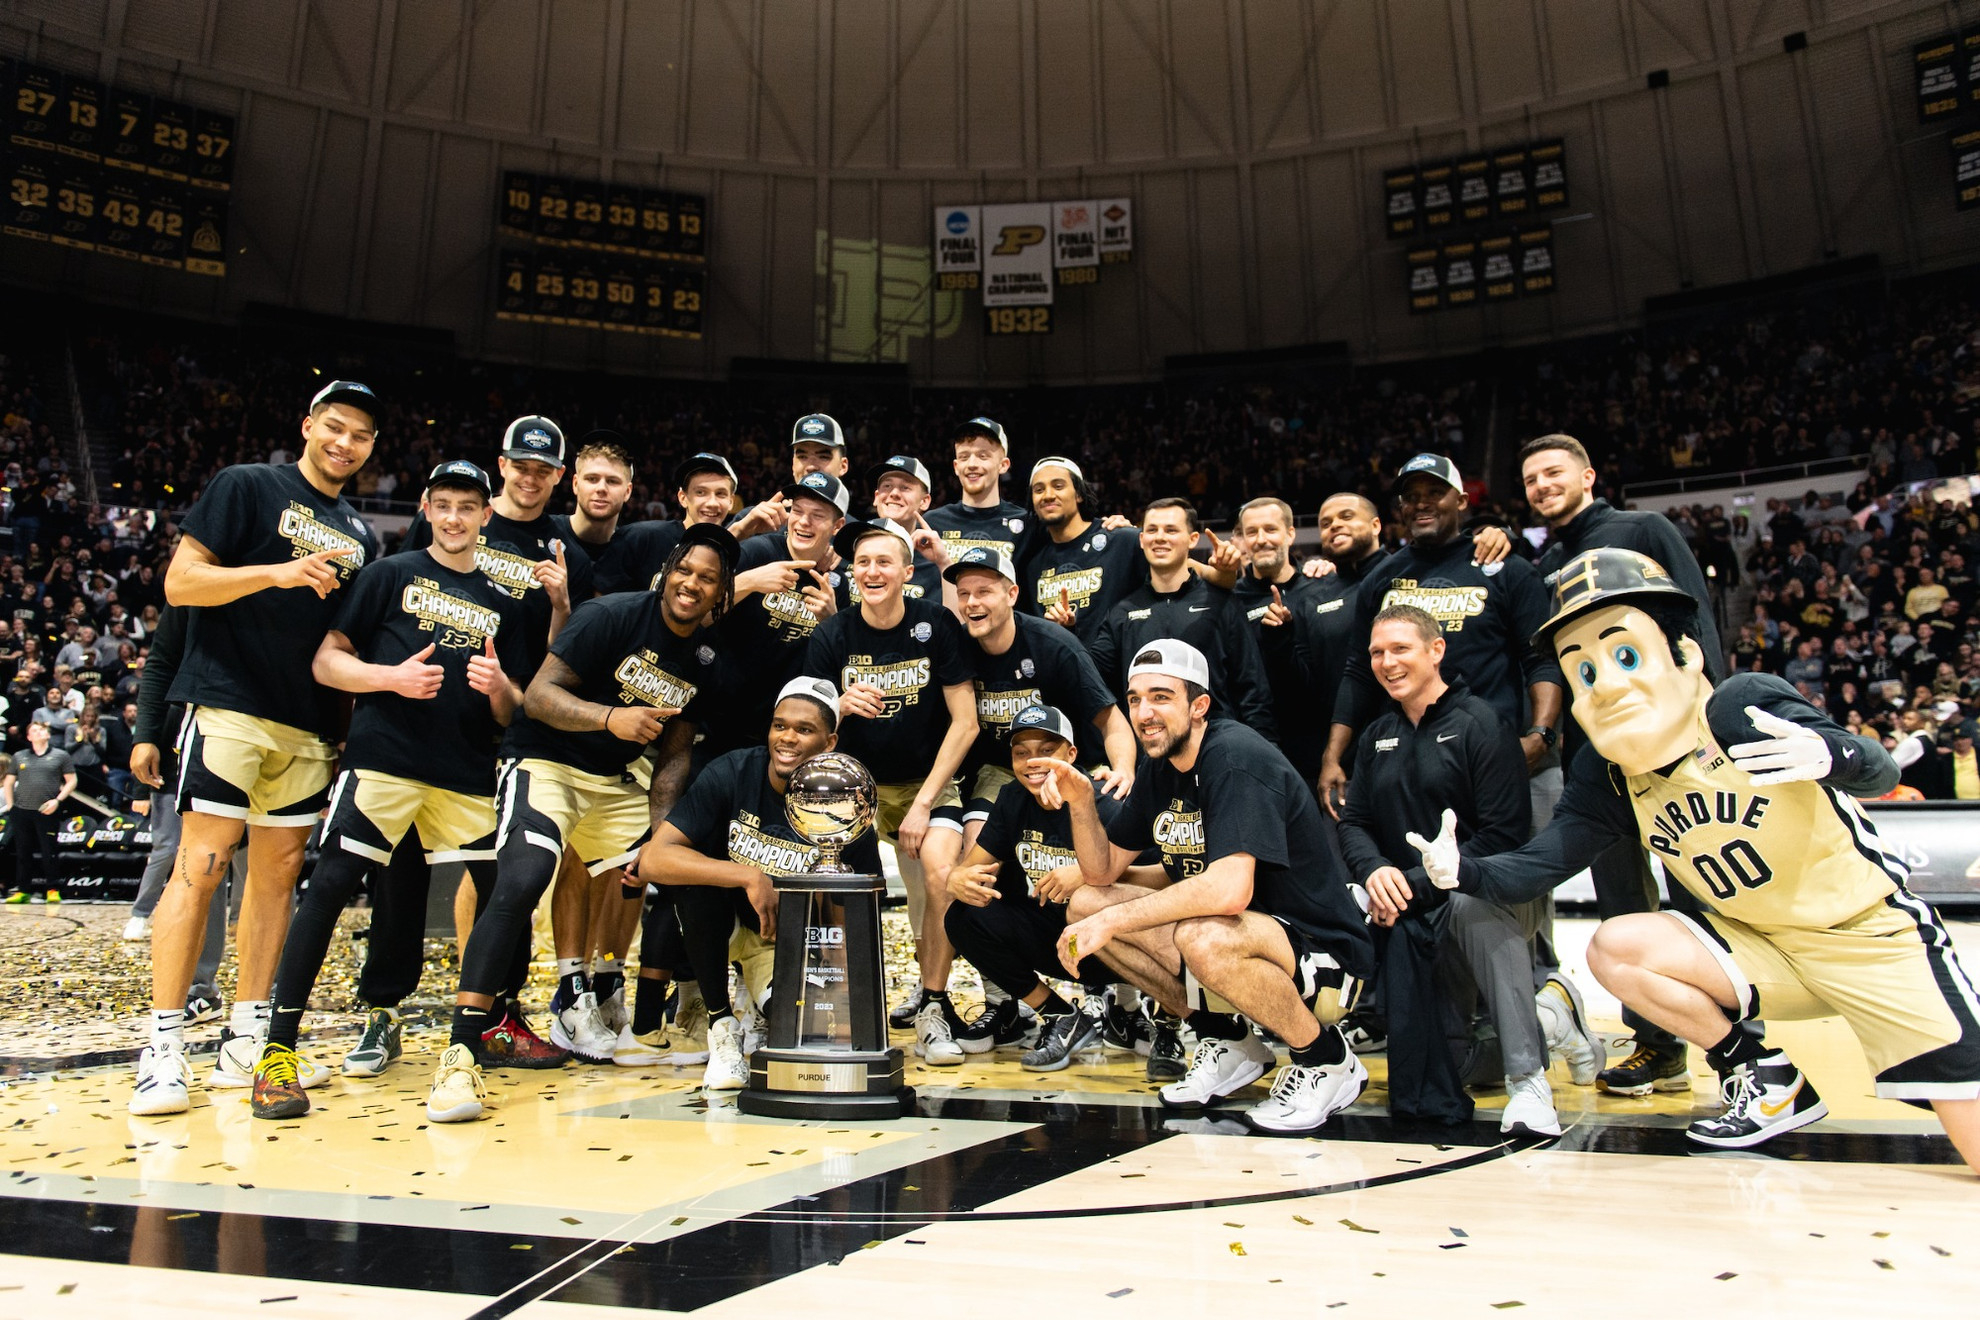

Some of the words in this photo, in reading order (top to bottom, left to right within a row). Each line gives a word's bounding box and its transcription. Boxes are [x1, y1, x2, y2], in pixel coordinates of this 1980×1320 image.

[16, 87, 57, 116] 27
[69, 100, 98, 128] 13
[119, 112, 138, 137] 7
[153, 122, 188, 151] 23
[195, 132, 230, 159] 37
[10, 178, 49, 208] 32
[57, 188, 94, 218] 35
[507, 189, 531, 211] 10
[102, 199, 140, 228] 43
[540, 196, 568, 219] 22
[573, 200, 602, 223] 23
[608, 204, 636, 227] 33
[146, 209, 183, 237] 42
[642, 209, 669, 232] 55
[678, 213, 701, 236] 13
[940, 238, 977, 251] FINAL
[1057, 231, 1095, 246] FINAL
[942, 251, 975, 264] FOUR
[1060, 246, 1094, 259] FOUR
[507, 270, 523, 292] 4
[536, 273, 565, 296] 25
[939, 272, 979, 289] 1969
[992, 273, 1043, 283] NATIONAL
[1058, 267, 1098, 285] 1980
[570, 278, 599, 300] 33
[607, 281, 635, 304] 50
[648, 286, 662, 308] 3
[988, 284, 1049, 295] CHAMPIONS
[672, 290, 700, 312] 23
[988, 307, 1049, 334] 1932
[510, 588, 526, 600] 23
[1037, 568, 1103, 600] CHAMPIONS
[406, 586, 500, 636] CHAMPIONS
[1079, 598, 1090, 608] 23
[418, 619, 435, 631] 20
[768, 617, 782, 629] 20
[1446, 620, 1463, 632] 23
[469, 637, 482, 649] 23
[619, 656, 698, 708] CHAMPIONS
[618, 690, 635, 704] 20
[905, 694, 919, 706] 23
[1648, 790, 1771, 858] PURDUE
[93, 830, 124, 841] GEMCO
[765, 837, 804, 851] BASKETBALL
[728, 821, 820, 873] CHAMPIONS
[1692, 839, 1773, 901] 00
[798, 1073, 831, 1082] PURDUE
